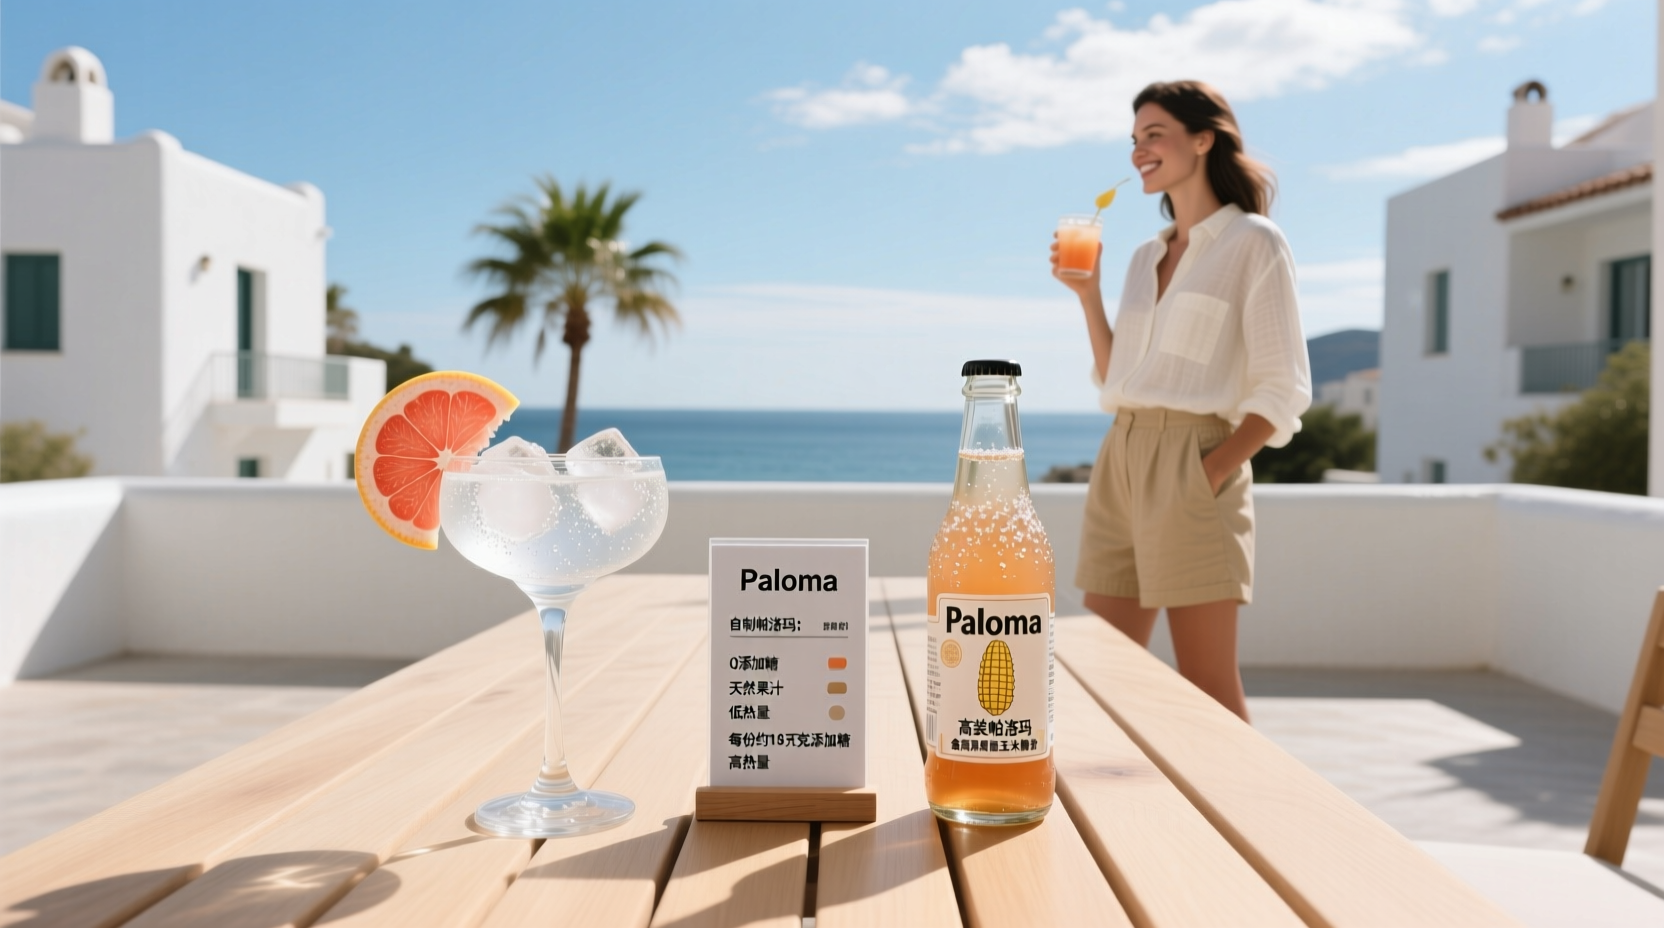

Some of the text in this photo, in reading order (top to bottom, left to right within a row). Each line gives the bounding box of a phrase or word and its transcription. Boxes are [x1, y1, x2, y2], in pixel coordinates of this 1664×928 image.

[740, 568, 838, 592] Paloma
[946, 605, 1042, 636] Paloma
[729, 680, 784, 696] 天然果汁
[728, 705, 770, 720] 低热量
[728, 754, 770, 770] 高热量
